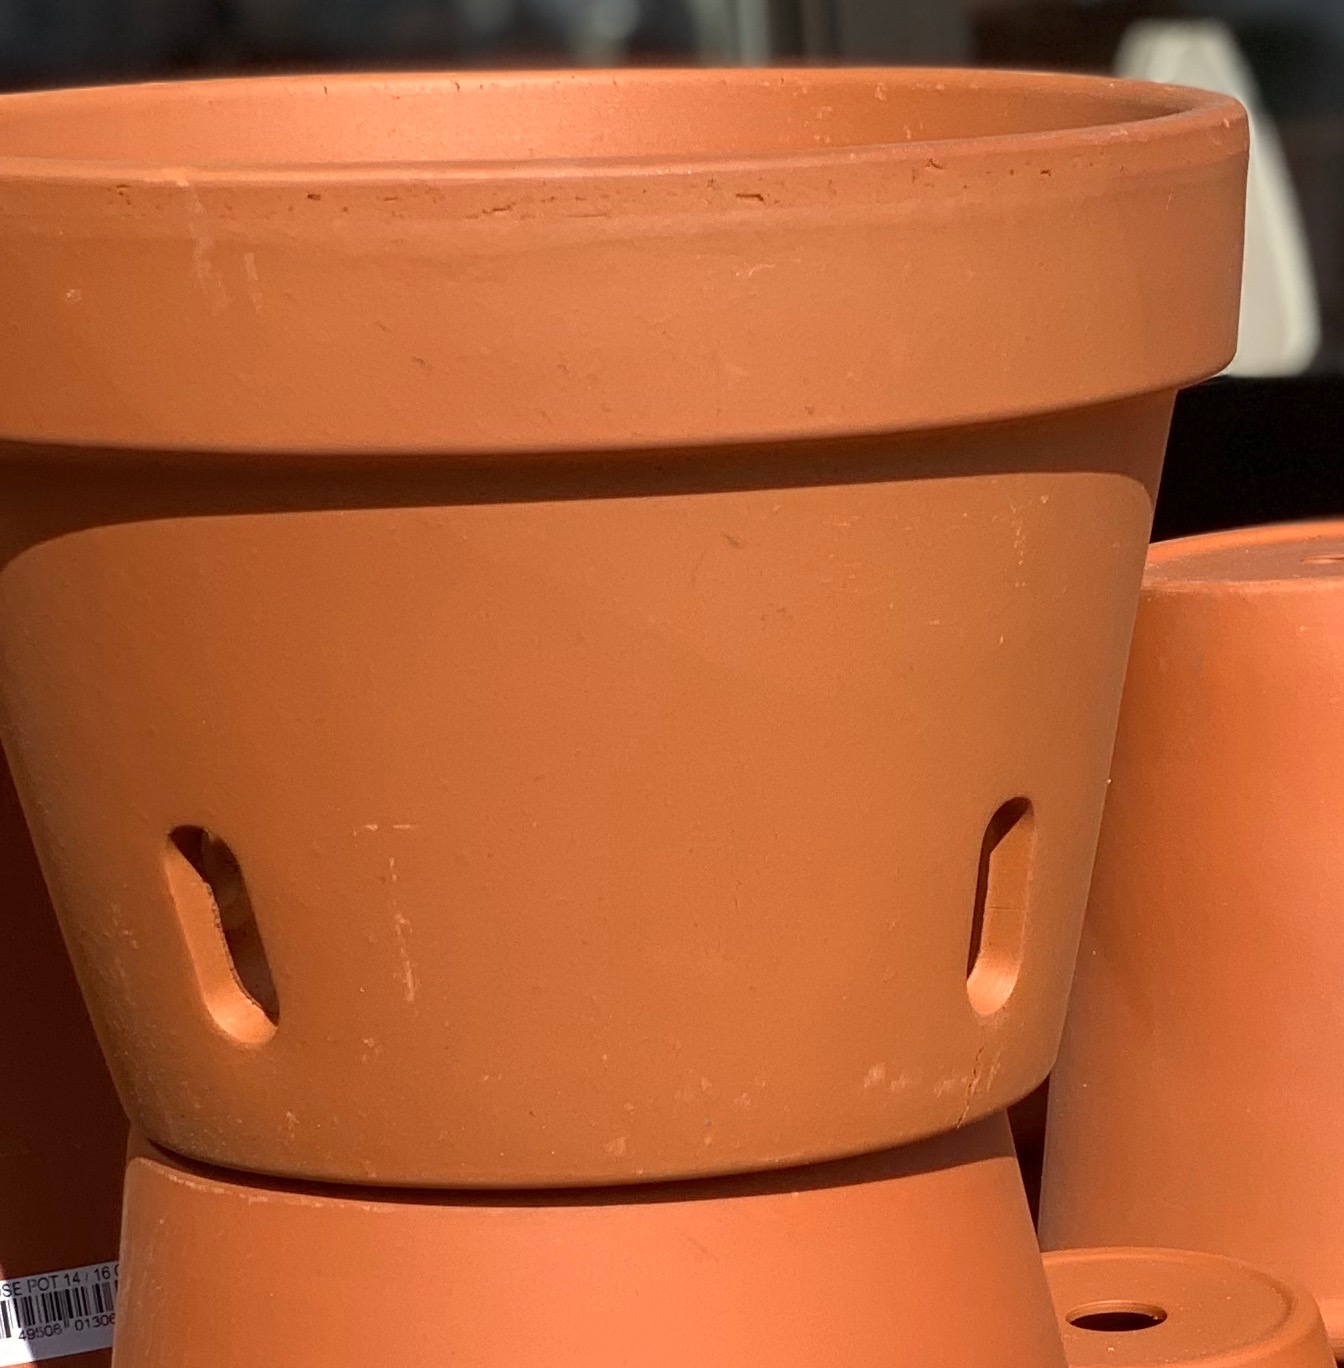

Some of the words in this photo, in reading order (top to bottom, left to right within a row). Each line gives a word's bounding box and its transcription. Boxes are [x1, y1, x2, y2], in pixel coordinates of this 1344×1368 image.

[28, 1275, 58, 1293] POT
[64, 1271, 81, 1287] 14
[94, 1266, 111, 1282] 16
[18, 1323, 63, 1340] 49508
